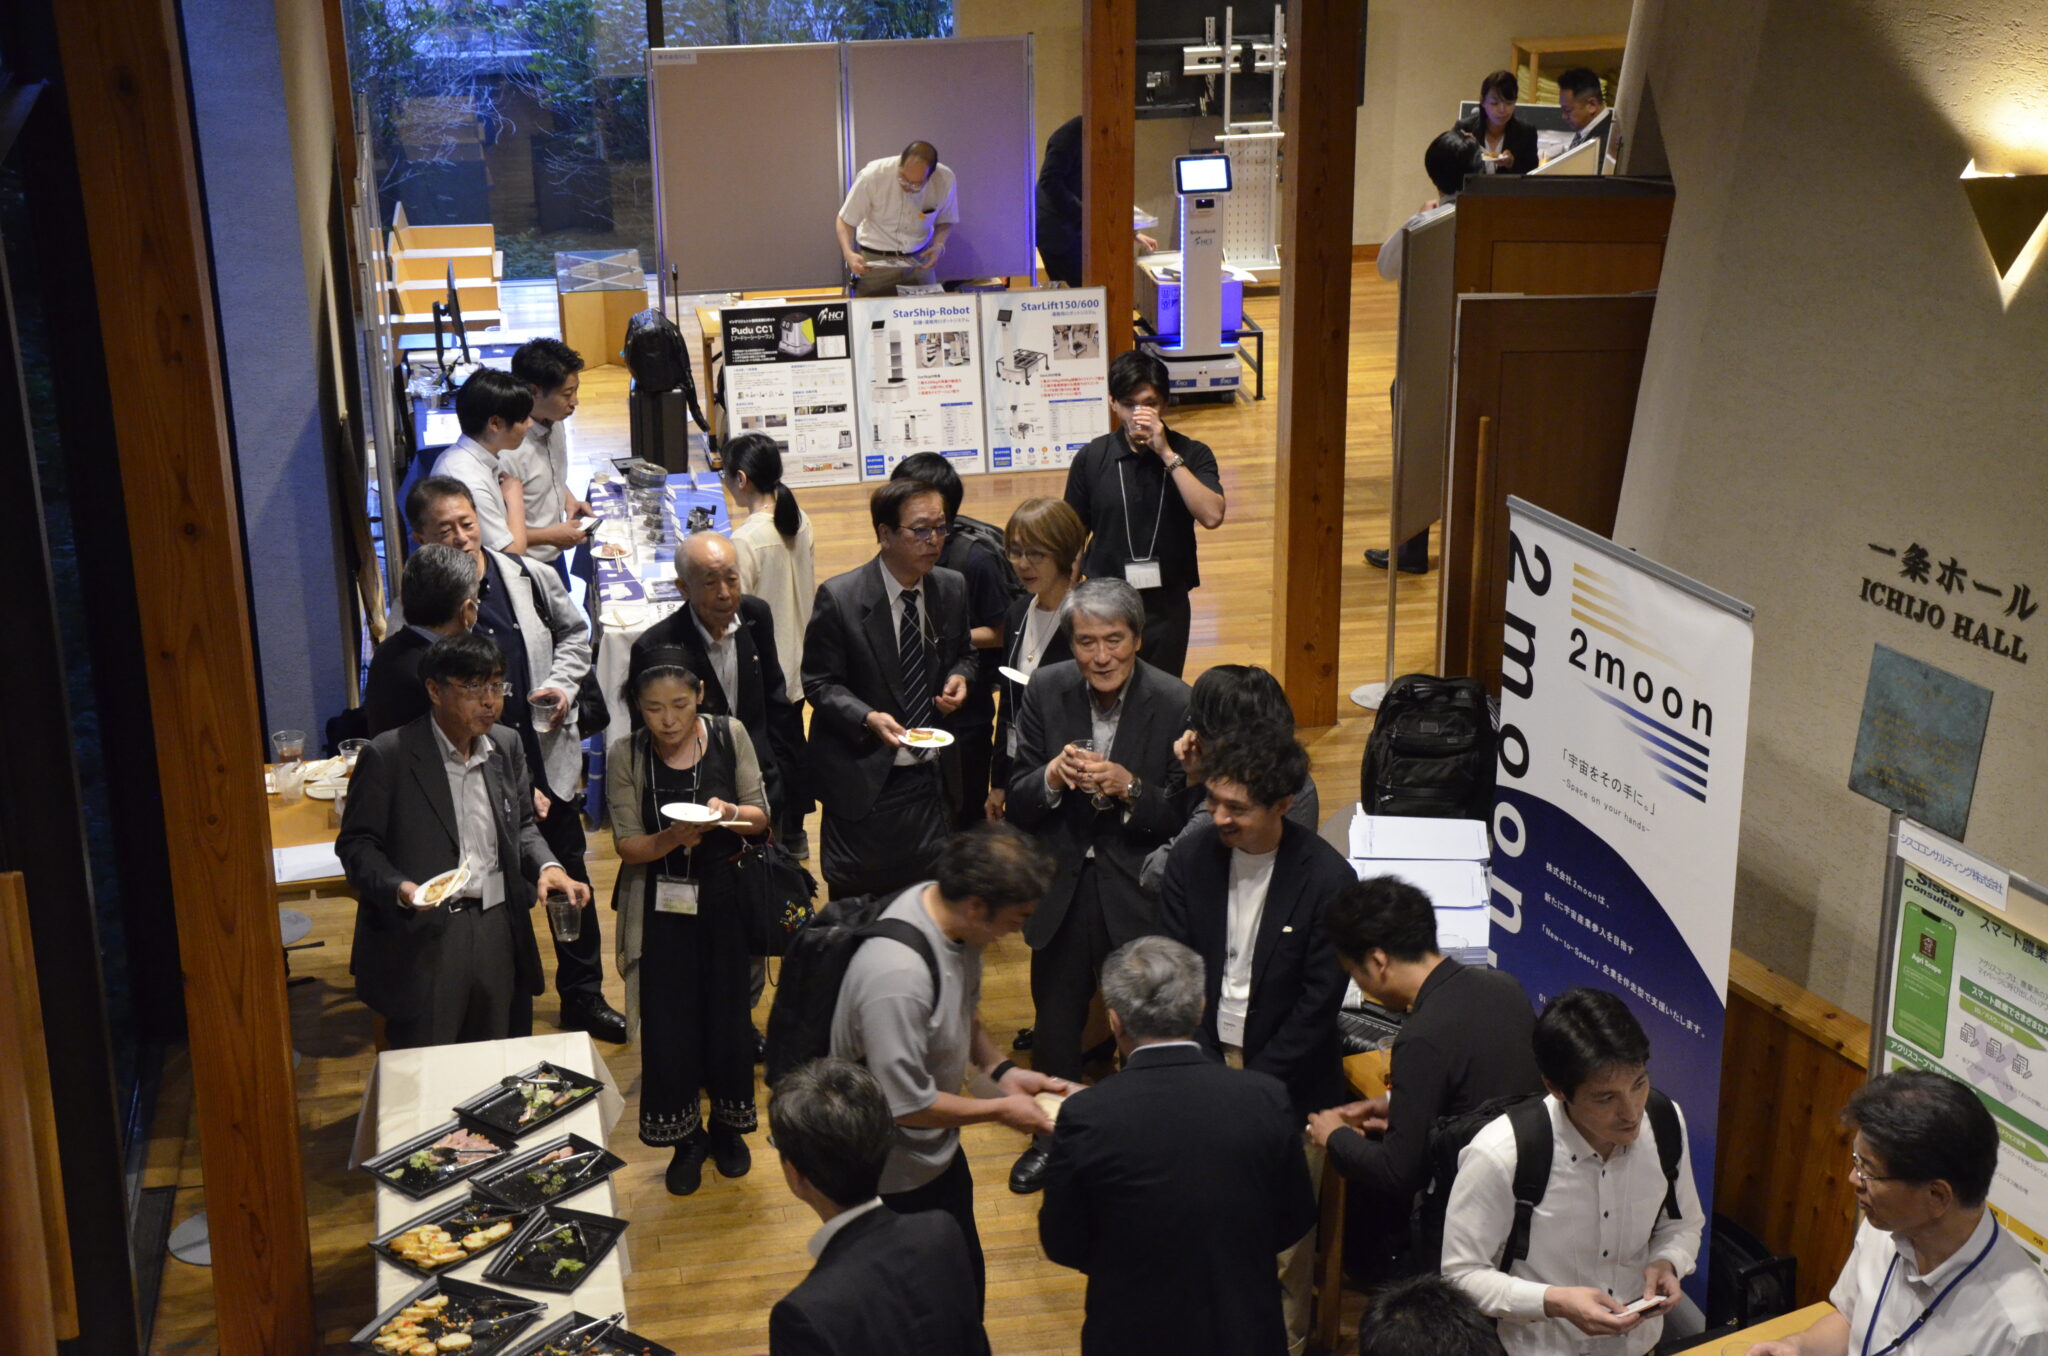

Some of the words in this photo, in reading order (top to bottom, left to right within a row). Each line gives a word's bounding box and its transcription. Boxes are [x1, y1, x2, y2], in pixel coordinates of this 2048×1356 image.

[827, 310, 845, 321] HCI
[892, 306, 970, 319] StarShip-Robot
[1021, 299, 1099, 312] StarLift150/600
[731, 327, 754, 336] Pudu
[755, 325, 773, 334] CC1
[1867, 541, 2040, 622] 一条ホール
[1858, 576, 1946, 630] ICHIJO
[1950, 611, 2029, 665] HALL
[1568, 628, 1714, 738] 2moon
[1561, 748, 1656, 816] 「宇宙をその手に。」
[1591, 795, 1601, 806] on
[1603, 801, 1622, 818] your
[1545, 861, 1610, 908] 株式会社2moonは、
[1899, 833, 2004, 897] シスココンサルティング株式会社
[1904, 878, 1965, 918] Consulting
[1916, 872, 1960, 904] Sisco
[1544, 891, 1635, 955] 新たに宇宙産業参入を目指す
